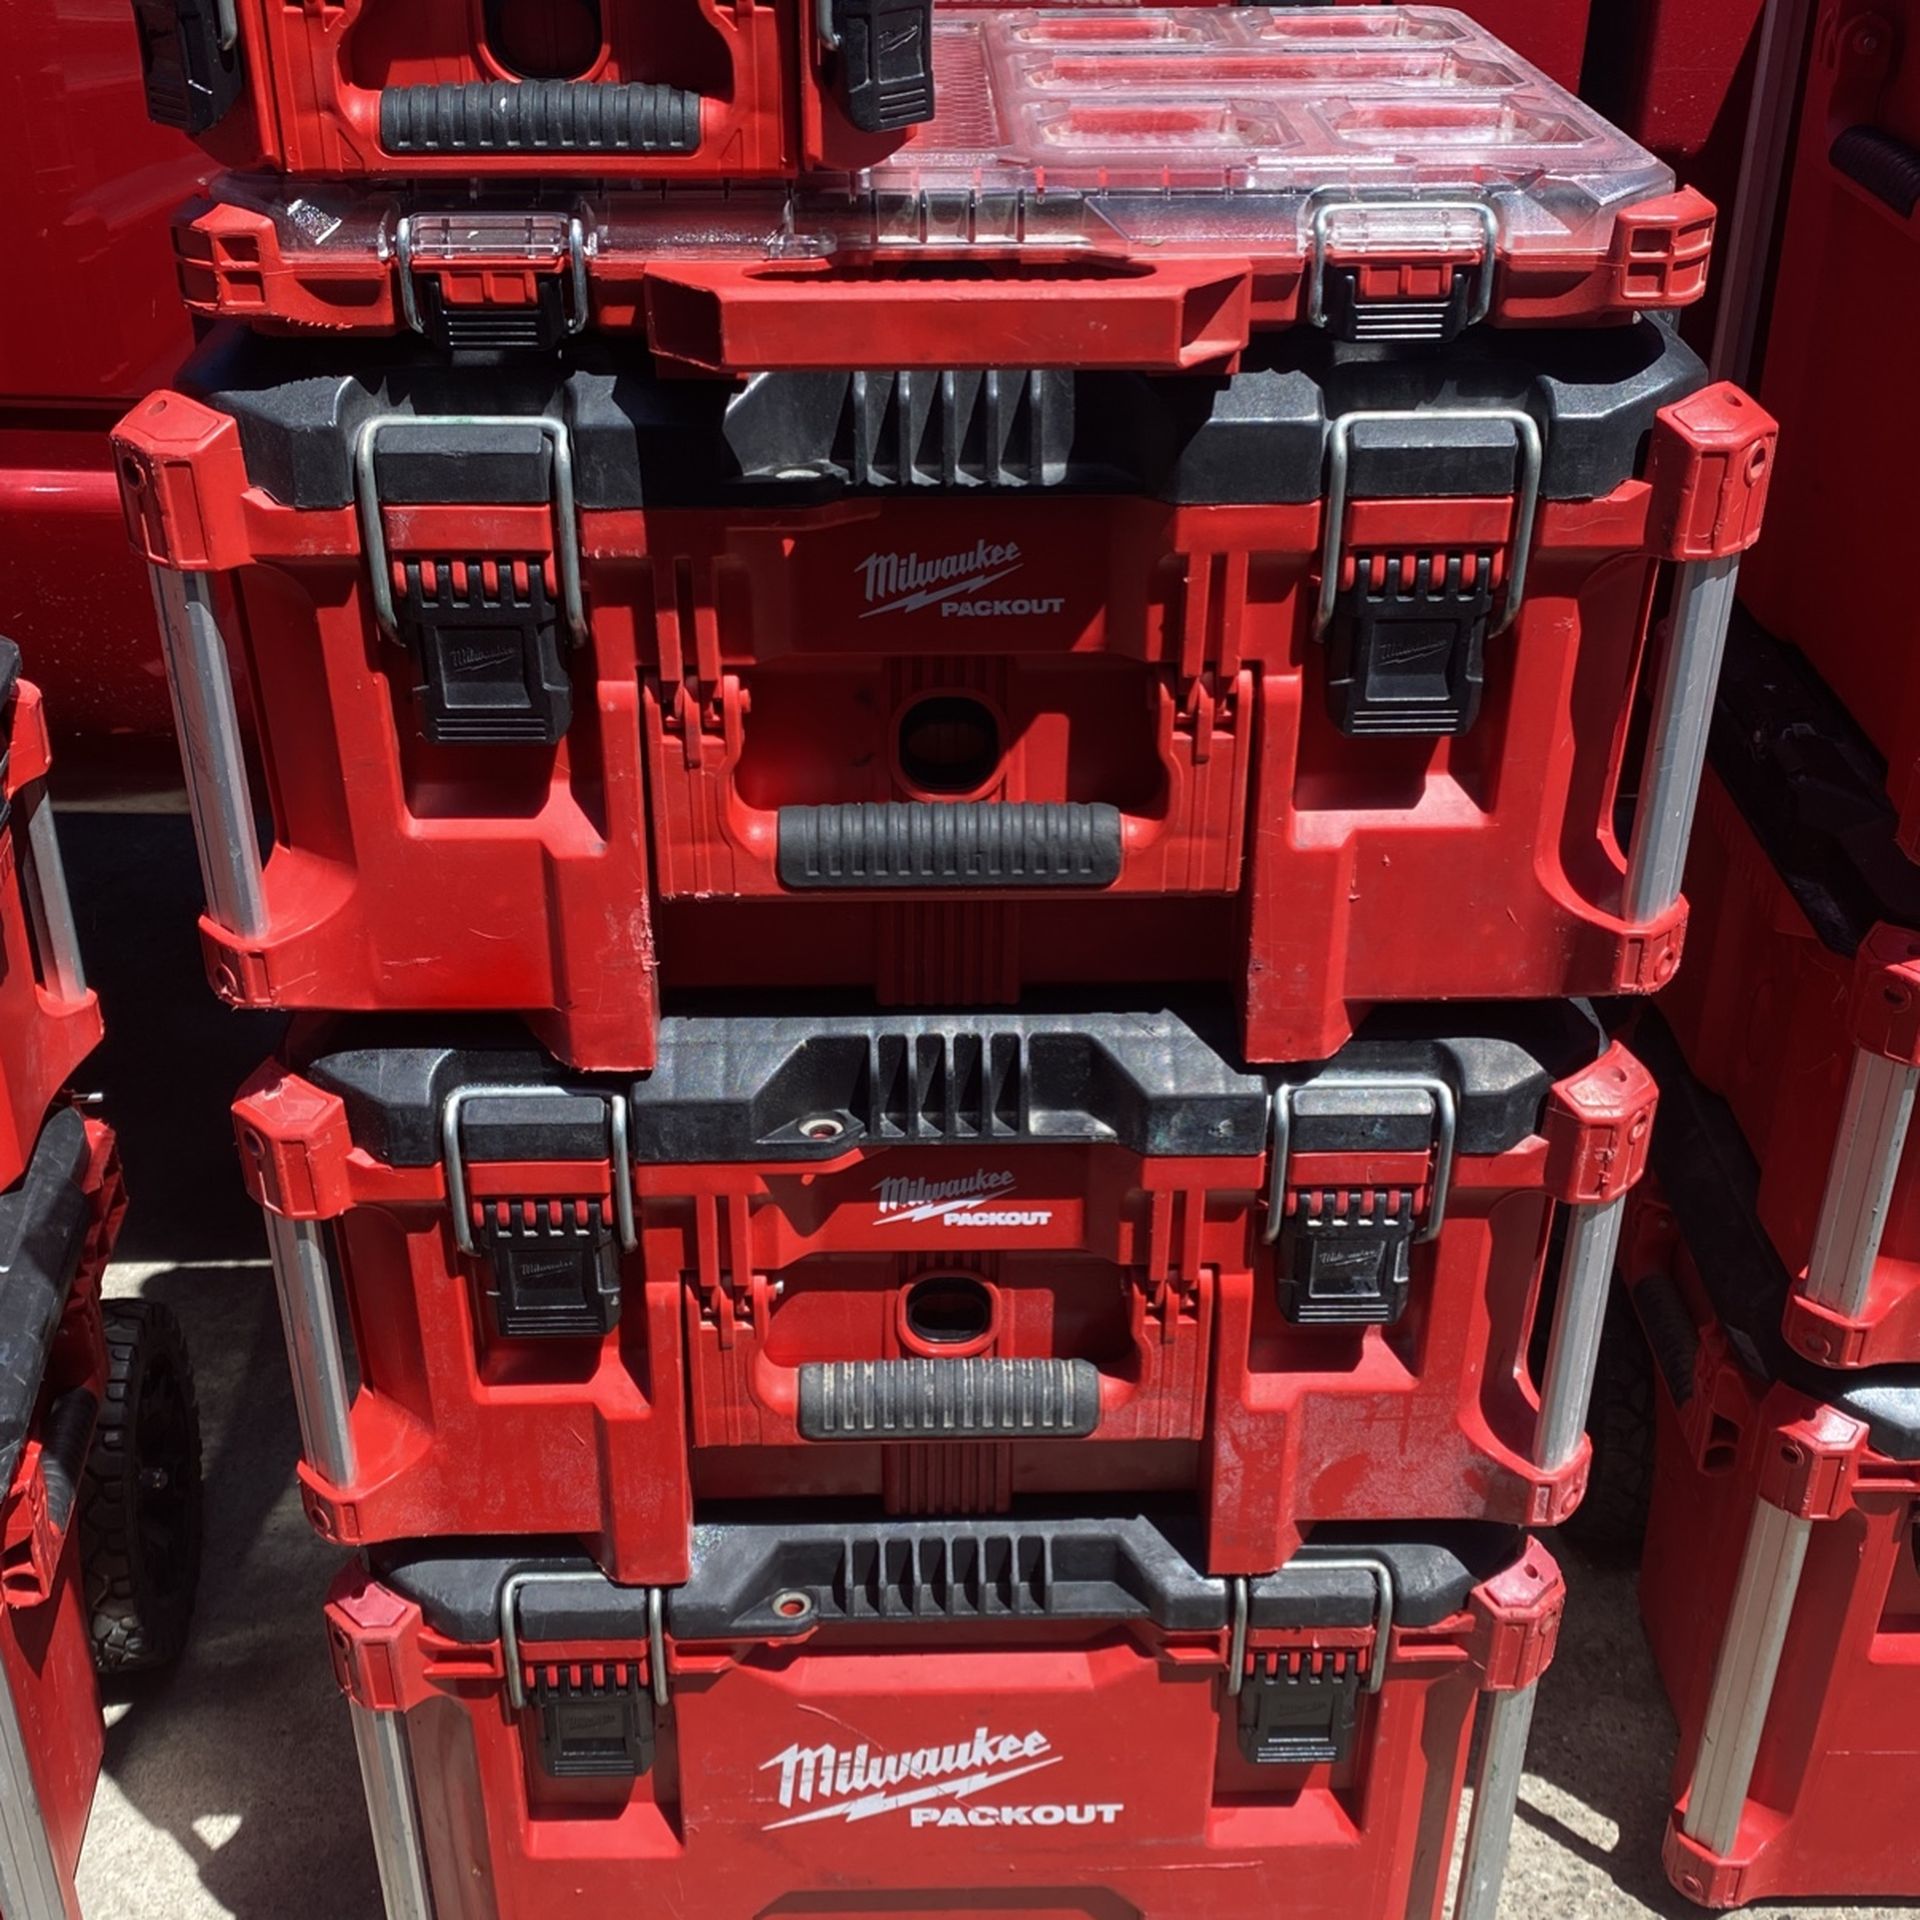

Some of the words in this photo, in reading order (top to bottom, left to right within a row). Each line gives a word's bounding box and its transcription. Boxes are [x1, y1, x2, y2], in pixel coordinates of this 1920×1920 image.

[854, 538, 1022, 602] Milwaukee
[941, 598, 1065, 617] PACKOUT
[870, 1168, 1016, 1214] Milwaukee
[943, 1211, 1053, 1226] PACKOUT
[759, 1727, 1051, 1808] Milwaukee
[910, 1804, 1124, 1827] PACKOUT
